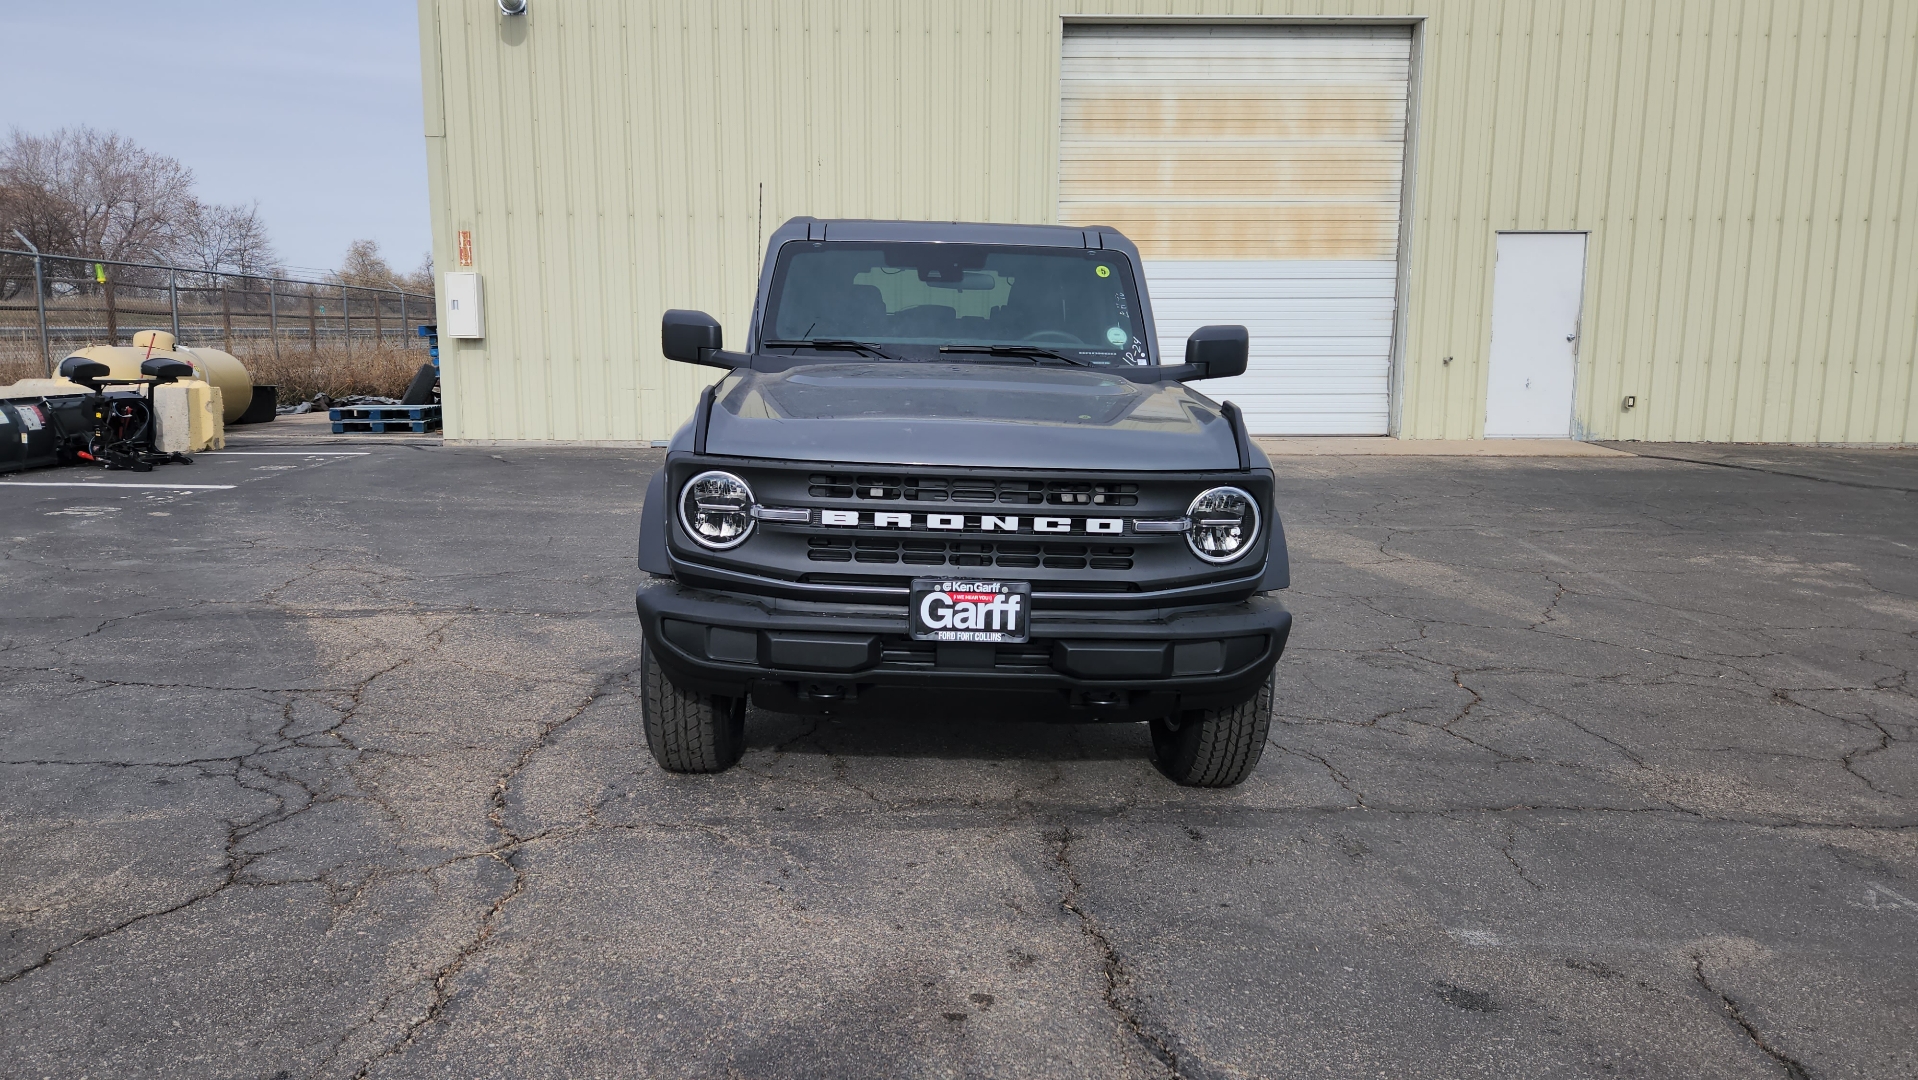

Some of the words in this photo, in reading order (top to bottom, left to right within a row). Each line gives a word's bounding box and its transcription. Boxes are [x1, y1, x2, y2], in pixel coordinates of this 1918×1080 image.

[821, 509, 1124, 533] BRONCO
[952, 582, 973, 592] Ken
[974, 583, 1001, 593] Garff
[920, 592, 1021, 630] Garff
[938, 631, 956, 640] FORD
[957, 631, 974, 641] FORT
[975, 632, 1002, 642] COLLINS
